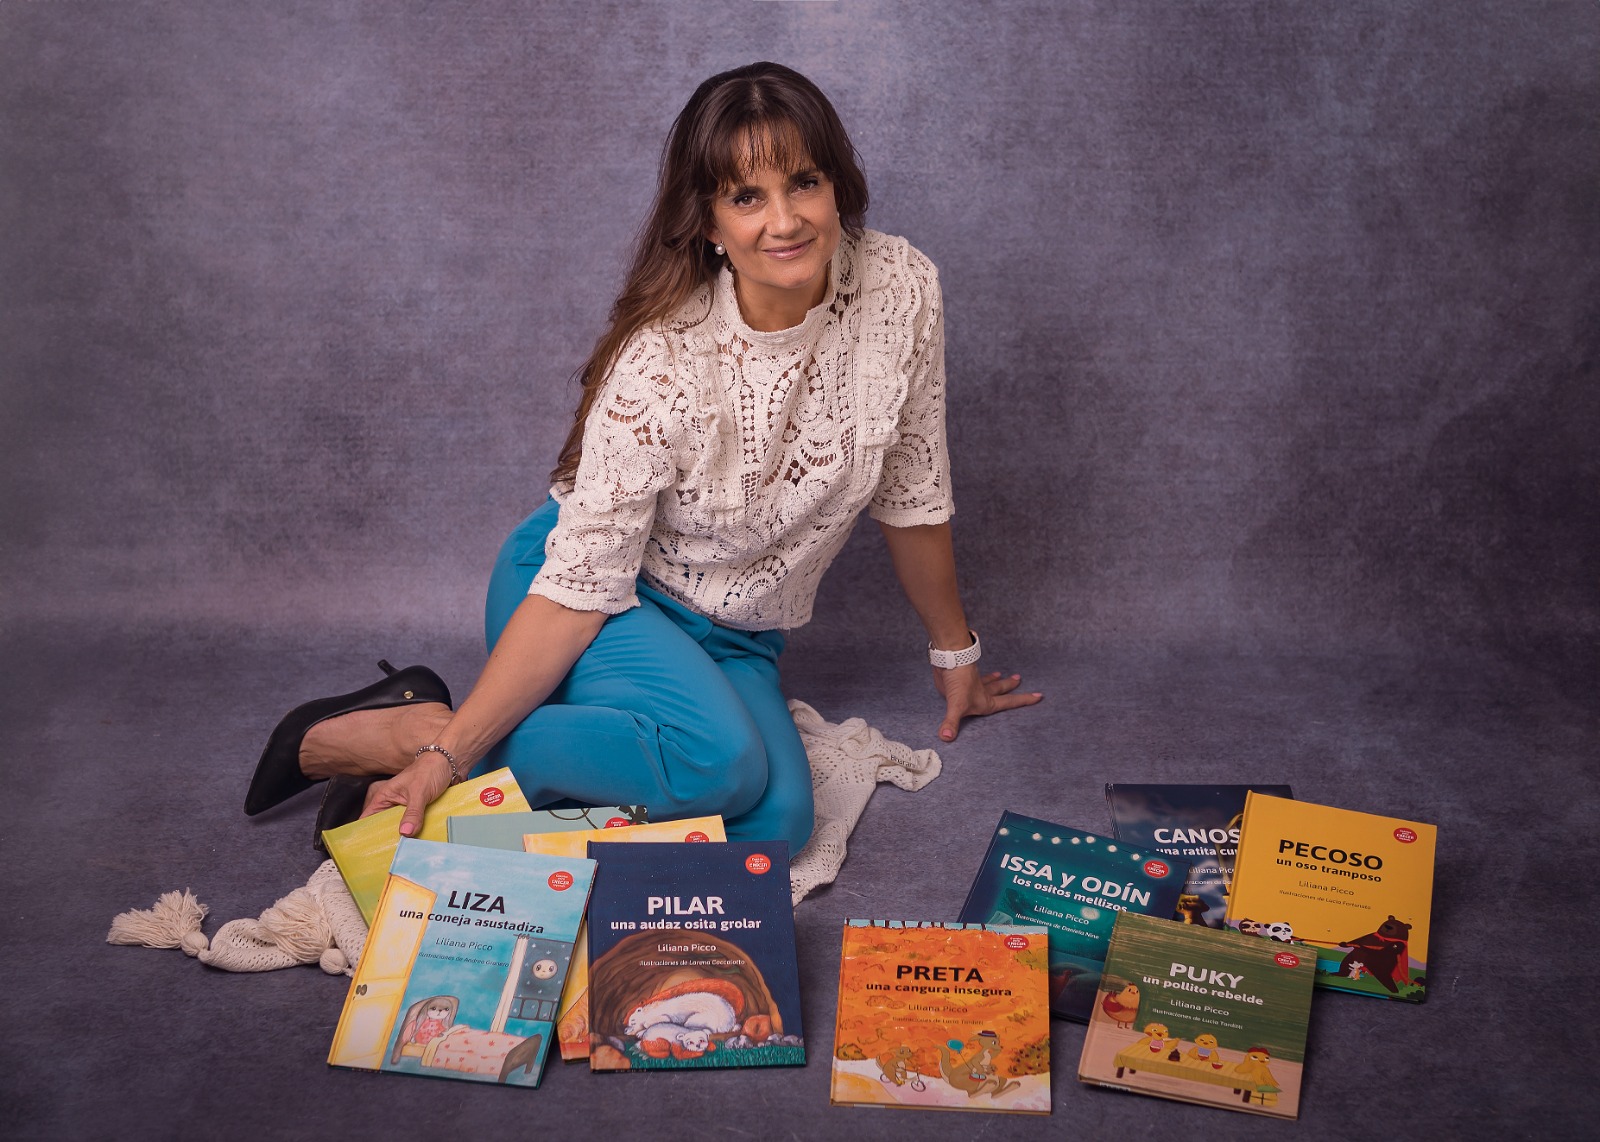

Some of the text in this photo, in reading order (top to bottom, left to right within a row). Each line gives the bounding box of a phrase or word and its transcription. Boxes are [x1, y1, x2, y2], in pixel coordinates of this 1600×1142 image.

[1183, 847, 1217, 856] ratita
[1279, 839, 1382, 870] PECOSO
[1276, 858, 1382, 882] un oso tramposo
[1000, 854, 1151, 906] ISSA y ODÍN
[1298, 881, 1354, 896] Liliana Picco
[448, 890, 505, 914] LIZA
[1012, 875, 1128, 912] los ositos mellizos
[648, 896, 725, 915] PILAR
[1034, 905, 1089, 925] Liliana Picco
[399, 909, 544, 934] una coneja asustadiza
[611, 918, 761, 931] una audaz osita grolar
[435, 937, 493, 951] Liliana Picco
[691, 944, 717, 952] Picco
[896, 964, 984, 982] PRETA
[1170, 962, 1244, 989] PUKY
[895, 983, 950, 994] cangura
[954, 985, 1012, 997] insegura
[1143, 976, 1264, 1006] un pollito rebelde
[1170, 999, 1230, 1016] Liliana Picco
